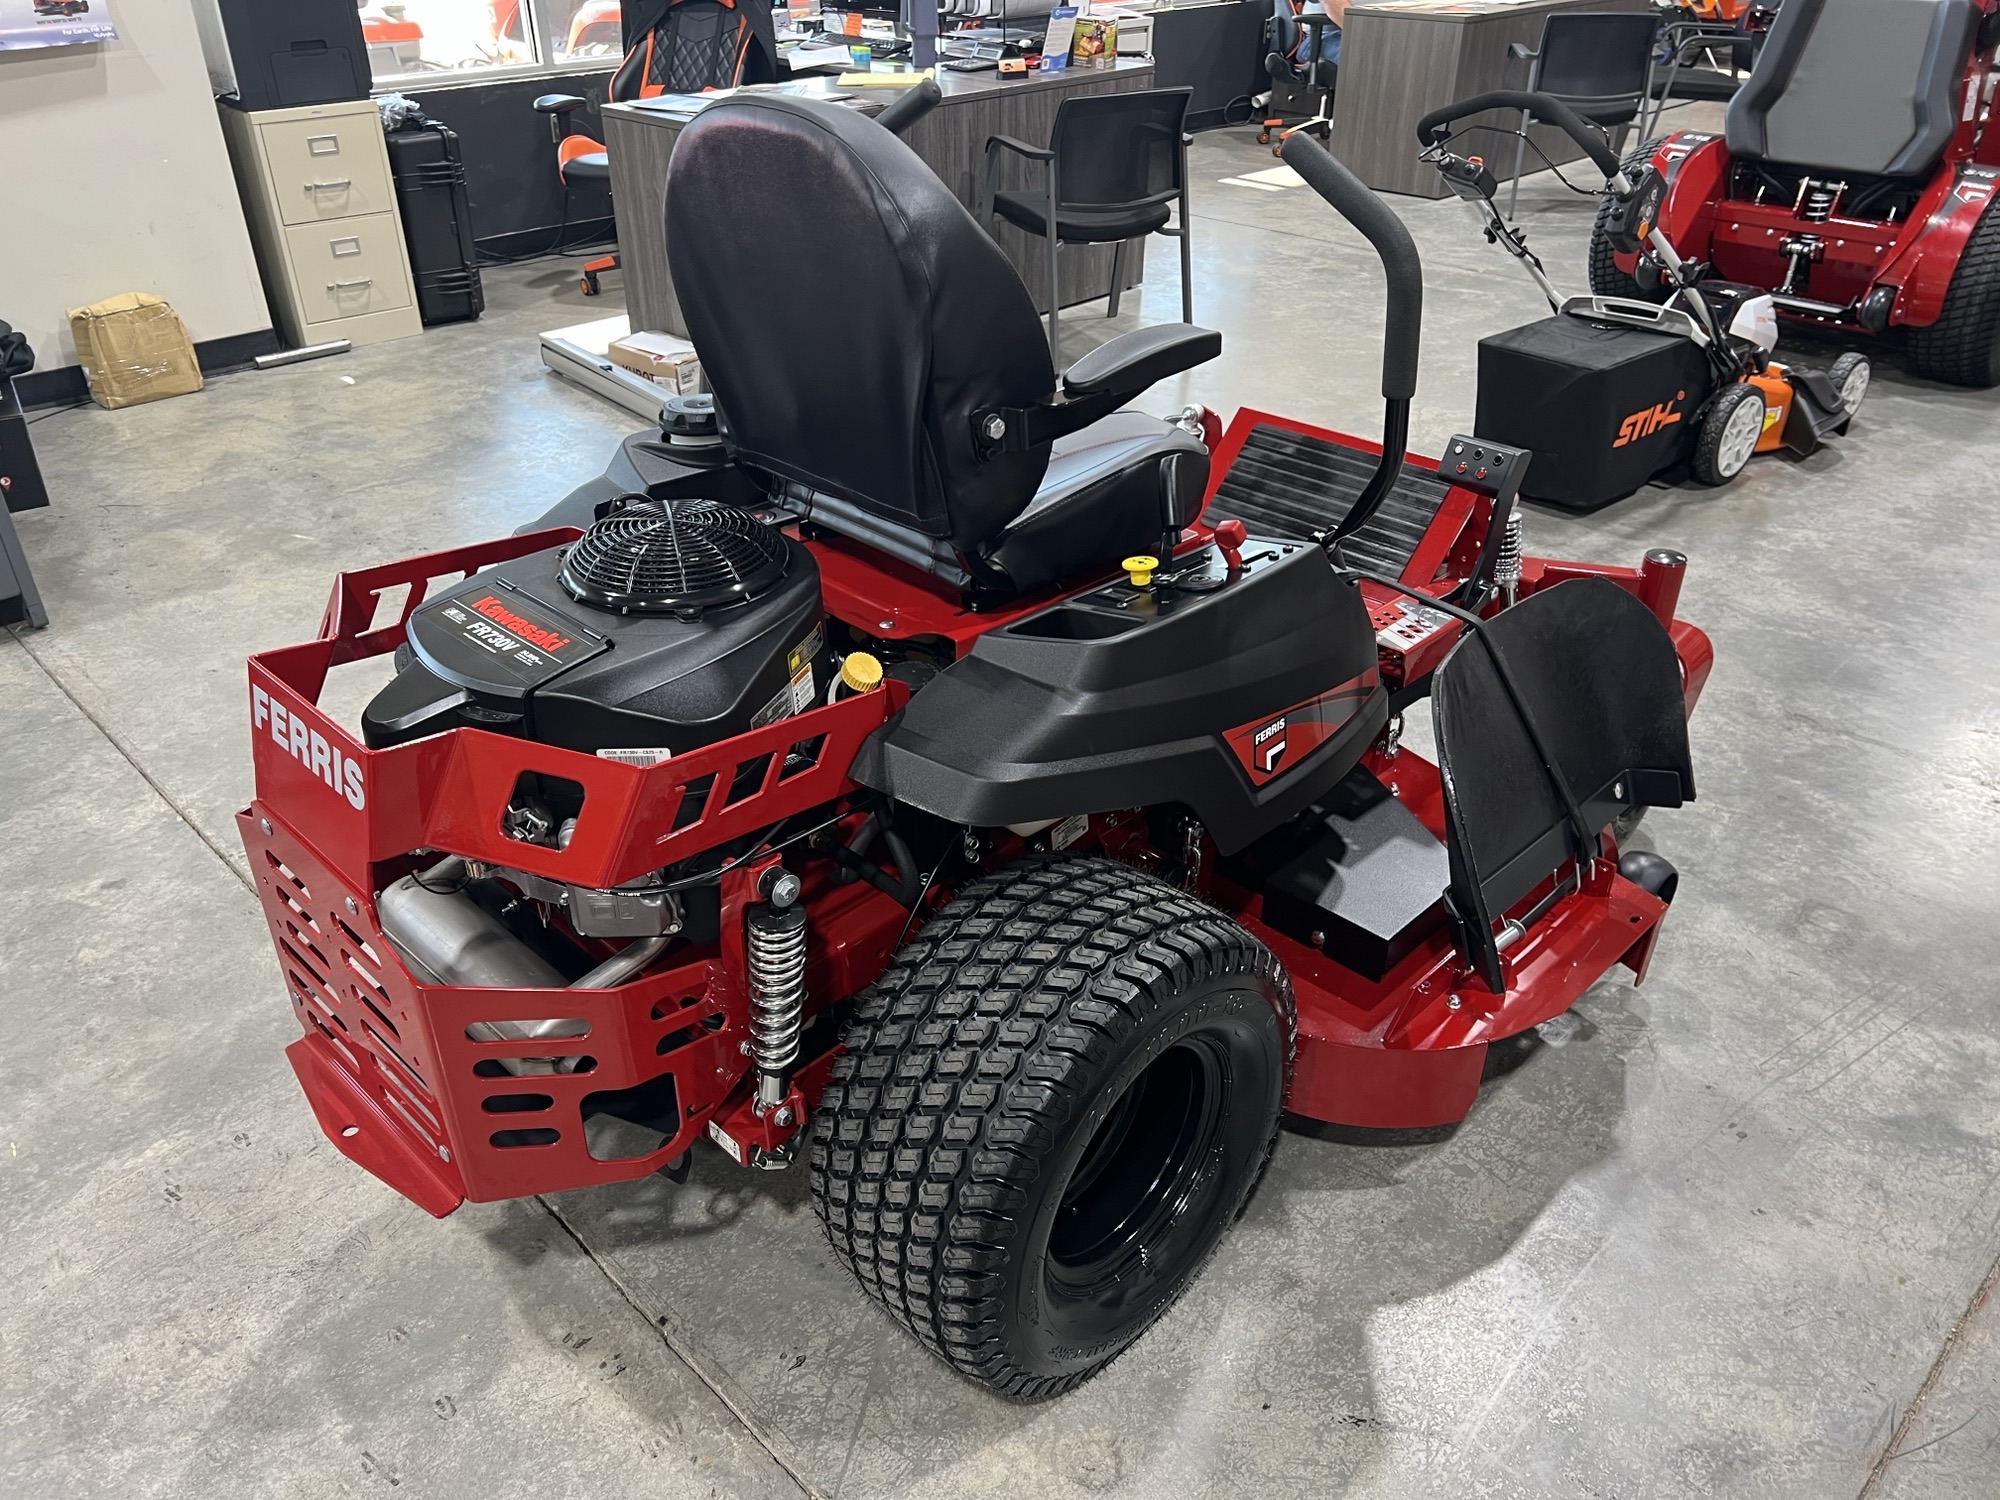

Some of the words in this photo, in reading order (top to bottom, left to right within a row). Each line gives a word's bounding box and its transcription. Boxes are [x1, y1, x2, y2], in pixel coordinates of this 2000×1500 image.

[1612, 398, 1682, 449] STIHL
[465, 621, 520, 651] FR730V
[471, 595, 570, 652] Kawasaki
[253, 683, 365, 811] FERRIS
[1255, 717, 1286, 746] FERRIS
